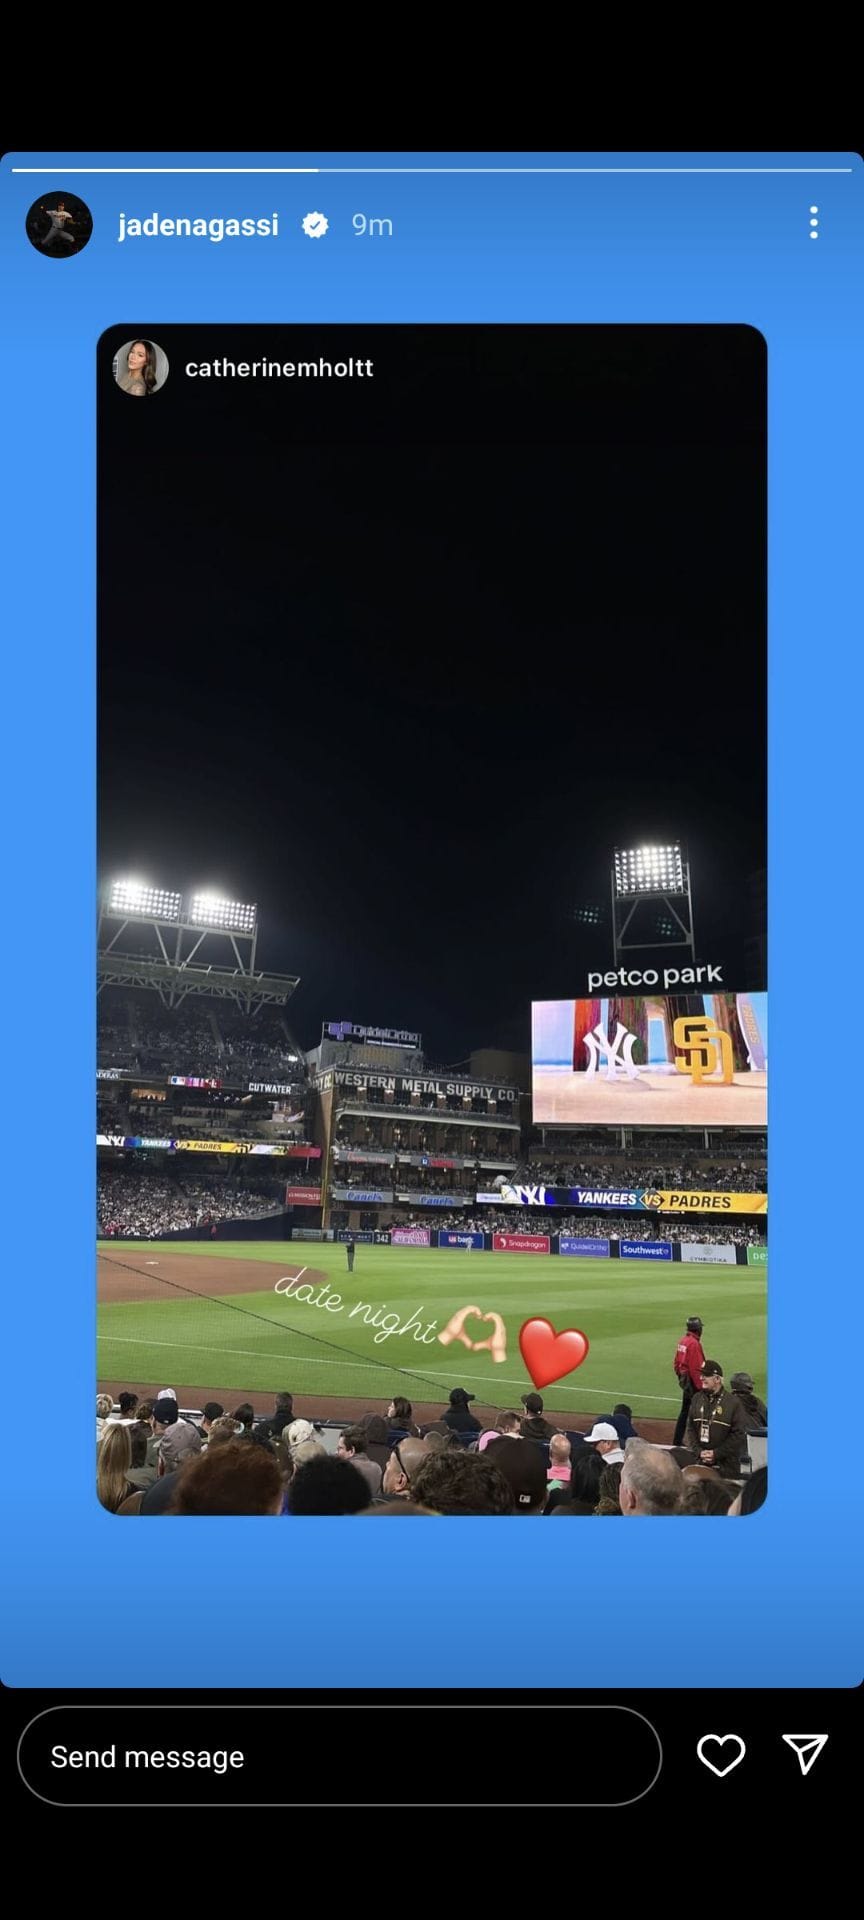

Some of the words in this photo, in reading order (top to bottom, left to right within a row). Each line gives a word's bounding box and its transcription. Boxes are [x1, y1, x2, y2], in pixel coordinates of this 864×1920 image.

[587, 967, 659, 993] petco
[663, 964, 724, 989] park
[249, 1082, 292, 1095] CUTWATER
[335, 1071, 396, 1090] WESTERN
[402, 1079, 443, 1095] METAL
[446, 1083, 493, 1099] SUPPLY
[141, 1139, 172, 1148] YANKEES
[194, 1142, 222, 1151] PADRES
[577, 1190, 637, 1206] YANKEES
[644, 1194, 662, 1206] VS
[669, 1195, 731, 1208] PADRES
[376, 1233, 389, 1243] 342
[508, 1239, 546, 1250] Snapdragon
[622, 1244, 664, 1256] Southwest
